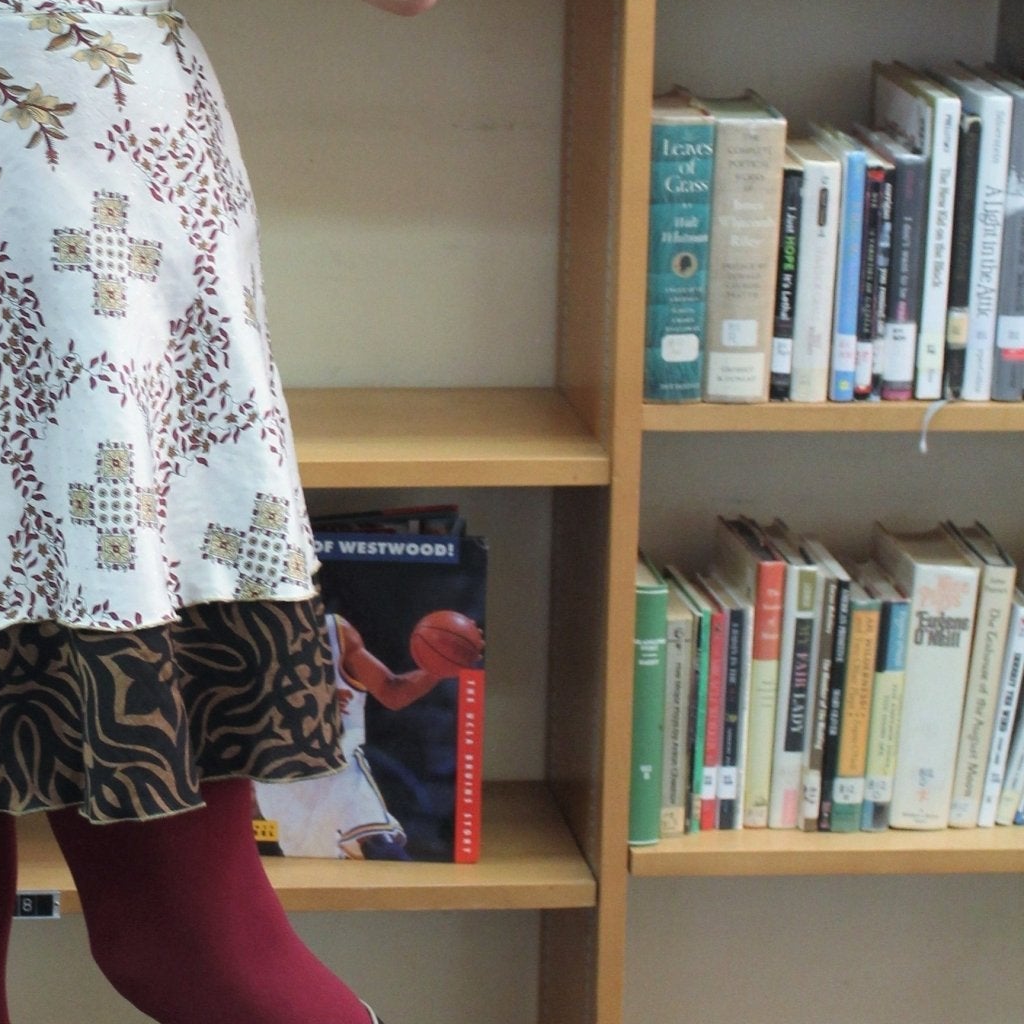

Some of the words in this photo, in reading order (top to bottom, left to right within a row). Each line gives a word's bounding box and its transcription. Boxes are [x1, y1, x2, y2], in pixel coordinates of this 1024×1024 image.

[663, 138, 713, 157] Leaves
[678, 159, 696, 175] of
[938, 167, 950, 184] The
[664, 177, 709, 193] Grass
[937, 185, 949, 207] New
[985, 184, 1002, 197] A
[784, 212, 796, 233] Just
[935, 209, 947, 226] Kid
[979, 200, 1002, 237] Light
[934, 227, 943, 240] on
[782, 236, 796, 271] HOPE
[933, 242, 944, 258] the
[982, 240, 998, 256] in
[931, 260, 943, 287] Block
[979, 258, 997, 283] the
[778, 289, 791, 320] Lethal
[975, 284, 995, 316] Attic
[314, 541, 334, 553] OF
[339, 540, 454, 556] WESTWOOD!
[916, 611, 969, 633] Eugene
[988, 607, 999, 627] The
[792, 651, 809, 688] FAIR
[977, 683, 989, 695] of
[788, 692, 806, 734] LADY
[974, 698, 986, 715] the
[466, 712, 475, 744] UCLA
[999, 709, 1009, 732] WIND
[966, 717, 984, 759] August
[465, 754, 474, 804] BRUINS
[963, 762, 977, 797] Moon
[463, 812, 473, 854] STORY
